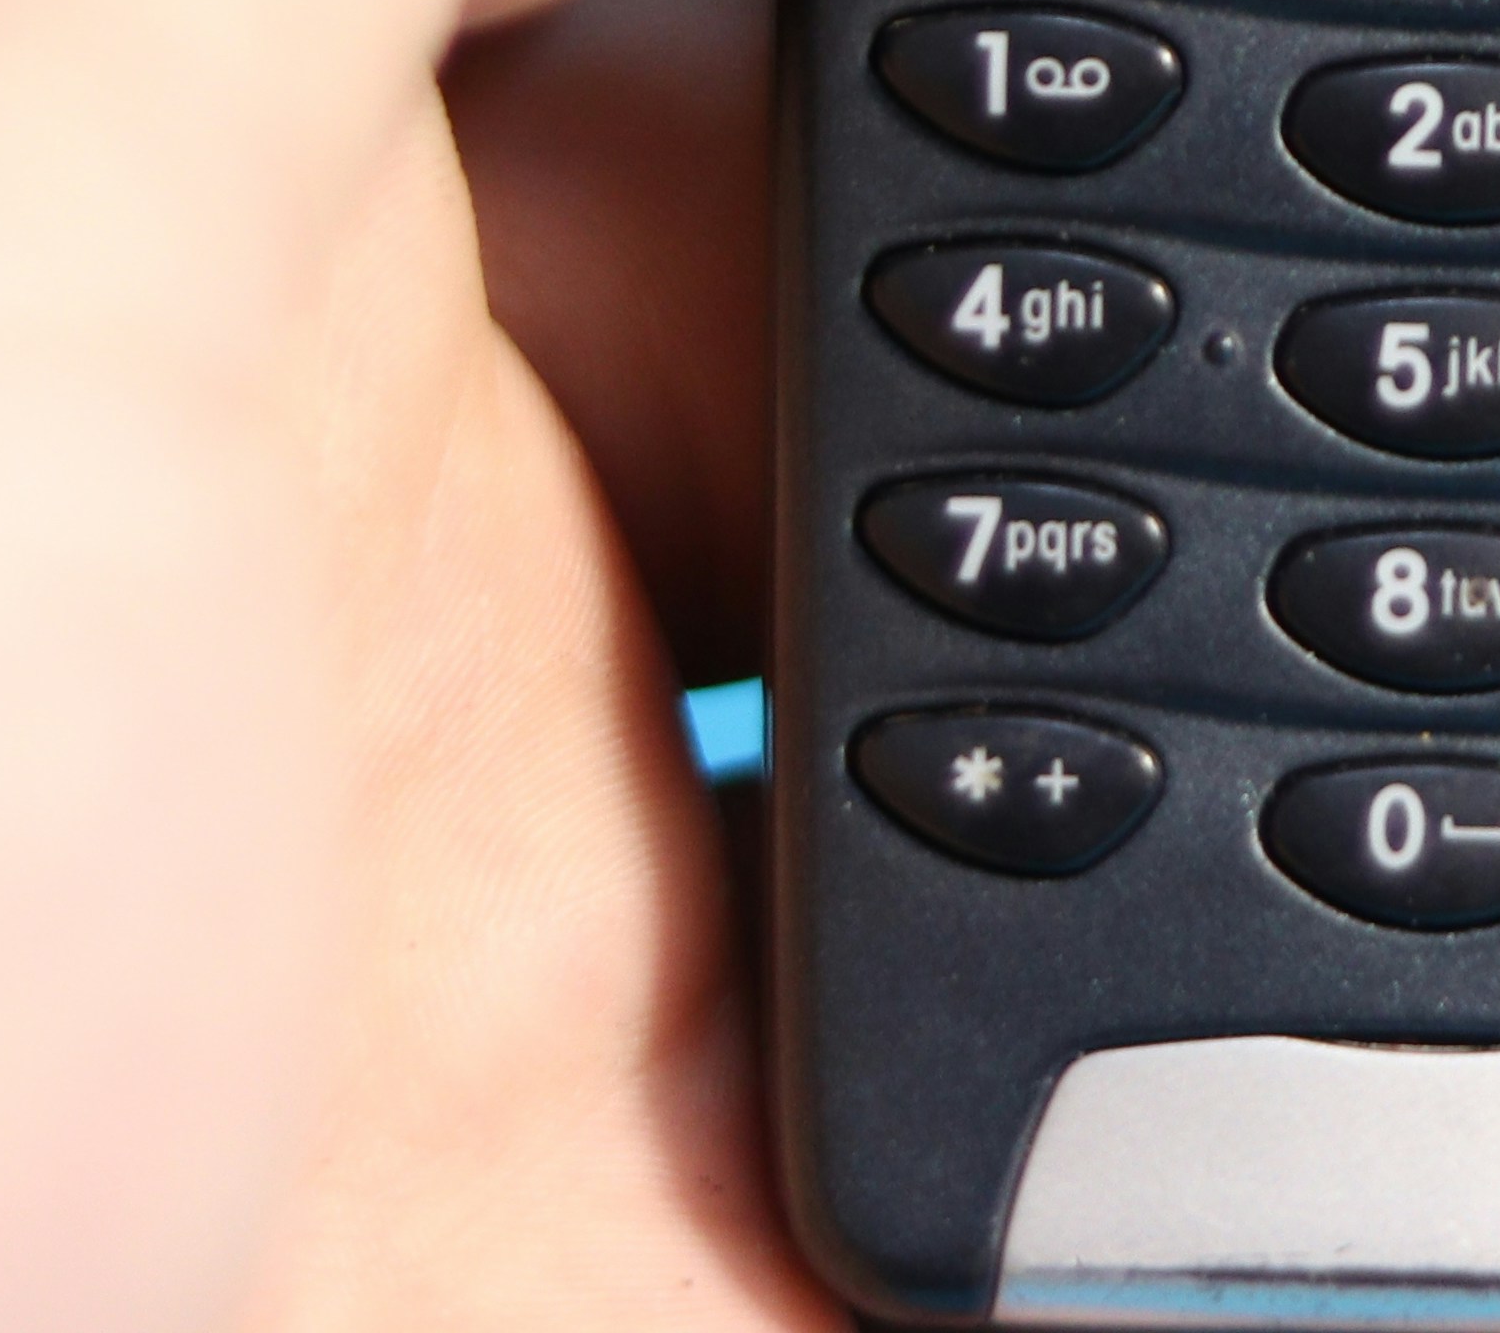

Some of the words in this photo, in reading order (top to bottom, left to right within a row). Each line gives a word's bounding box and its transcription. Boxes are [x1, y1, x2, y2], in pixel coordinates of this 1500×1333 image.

[974, 30, 1010, 117] 1
[1387, 81, 1447, 170] 2
[951, 263, 1011, 350] 4
[1019, 279, 1105, 345] ghi
[1375, 321, 1433, 410] 5
[1004, 519, 1118, 573] pqrs
[1370, 547, 1431, 637] 8
[1366, 782, 1427, 872] 0
